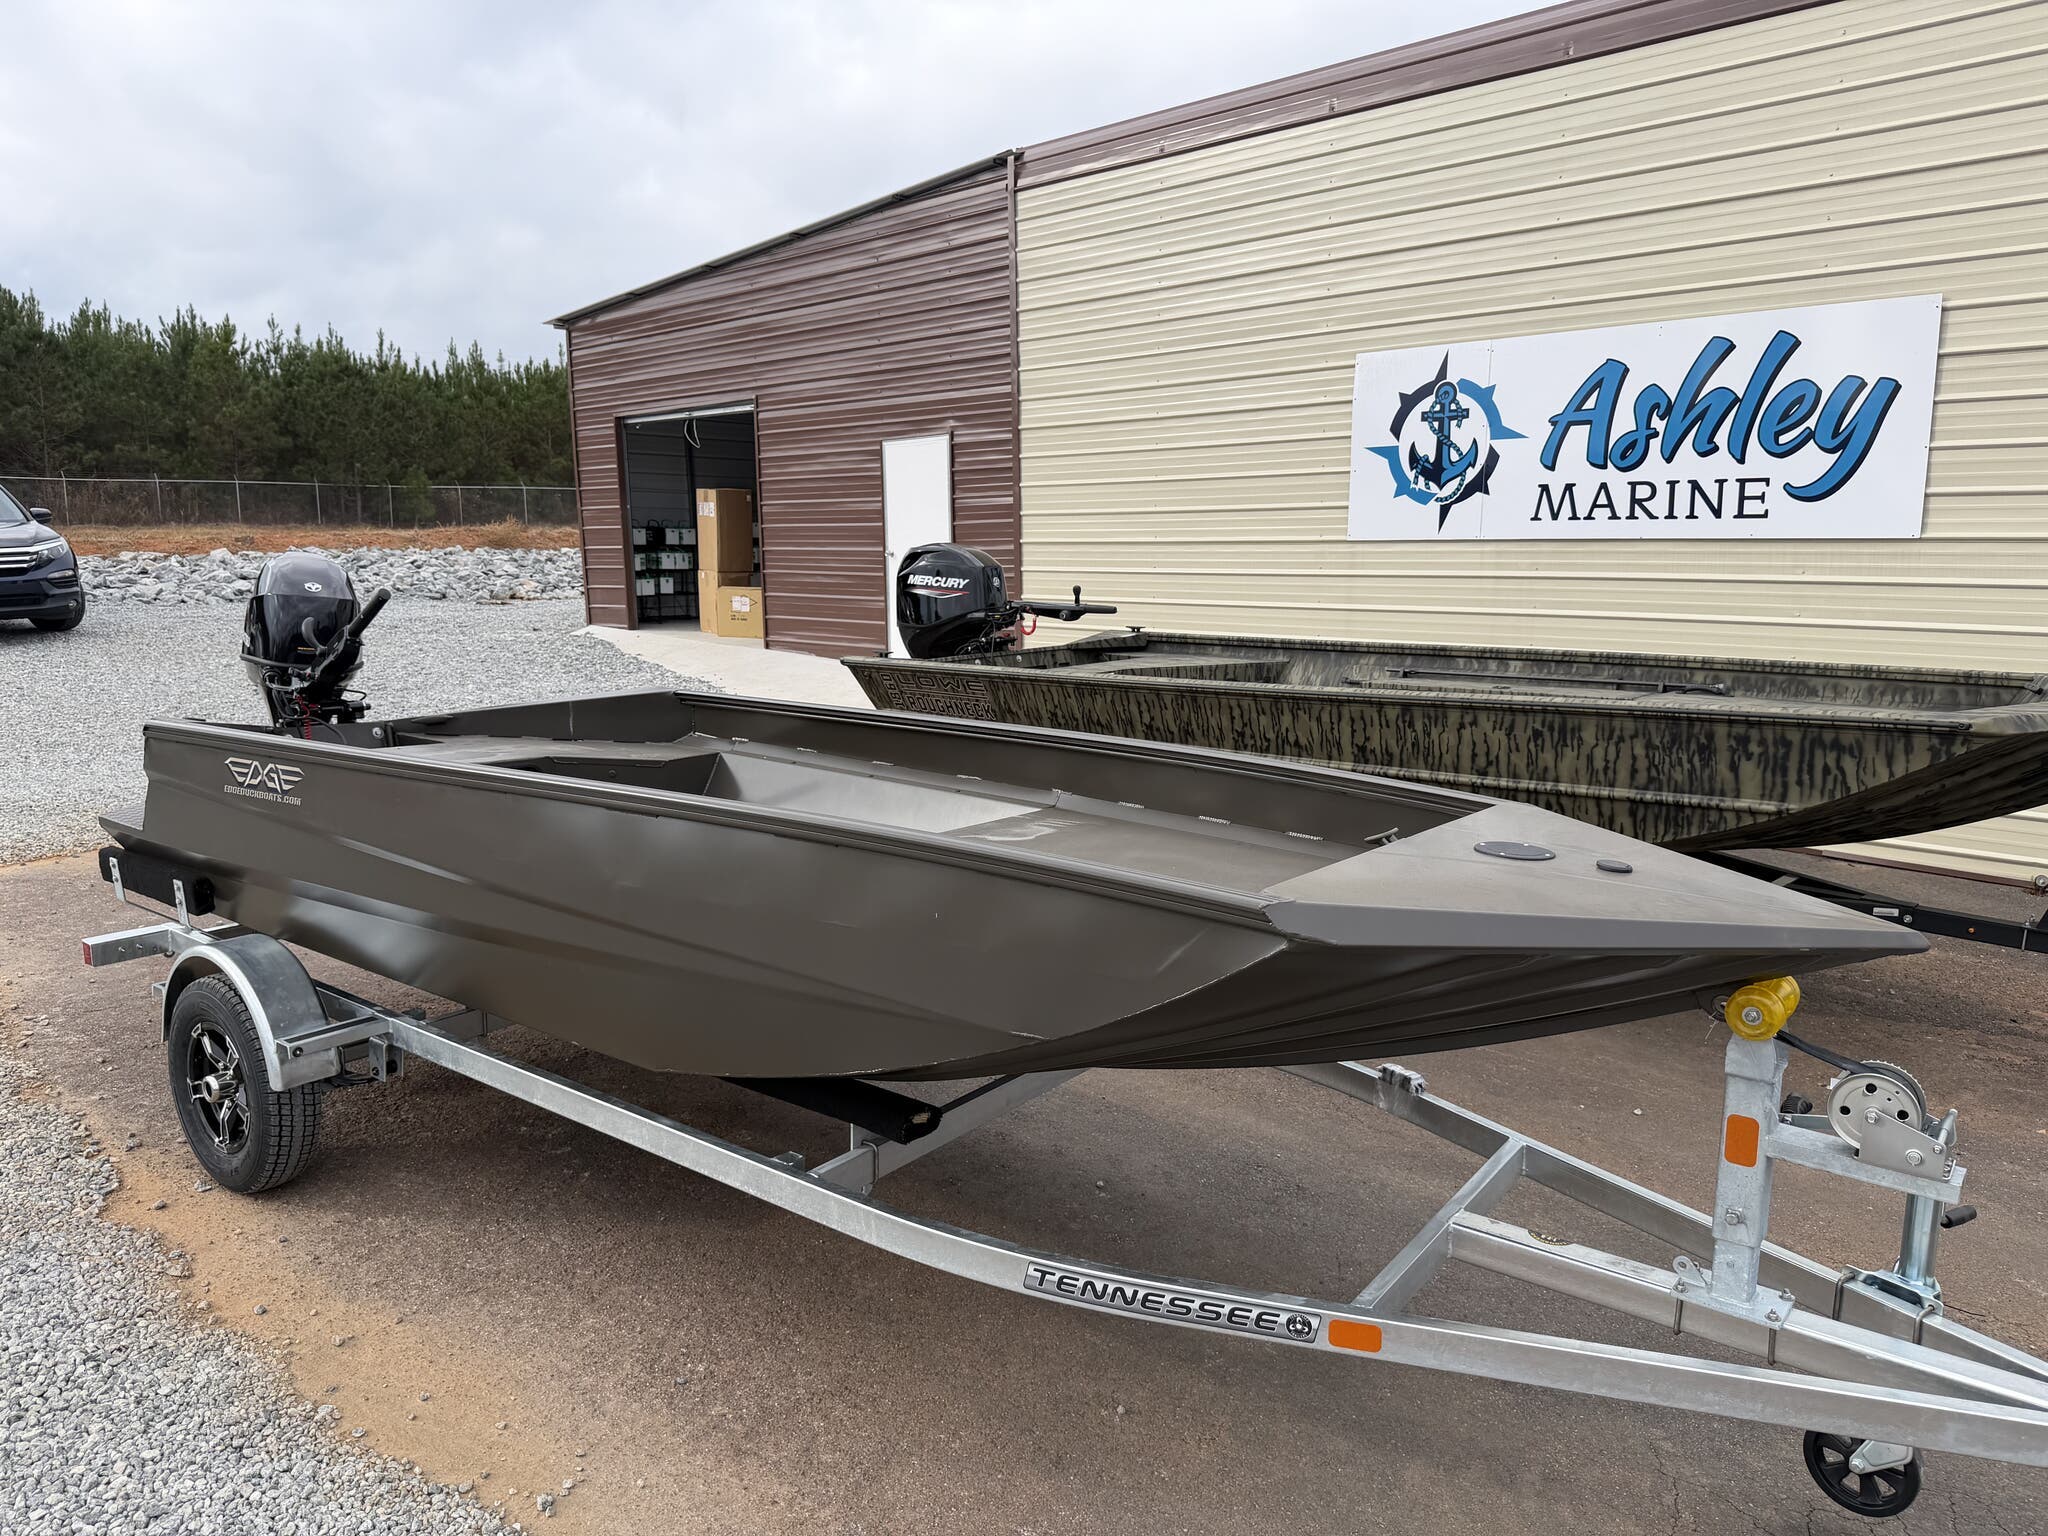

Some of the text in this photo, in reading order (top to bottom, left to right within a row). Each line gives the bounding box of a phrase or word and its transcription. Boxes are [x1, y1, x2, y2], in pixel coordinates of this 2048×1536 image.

[1540, 330, 1902, 502] Ashley
[1531, 477, 1771, 521] MARINE
[907, 574, 970, 589] MERCURY
[897, 673, 988, 694] LOWE
[906, 694, 996, 721] ROUGHNECK
[224, 756, 305, 794] EDGE
[1032, 1267, 1281, 1332] TENNESSEE
